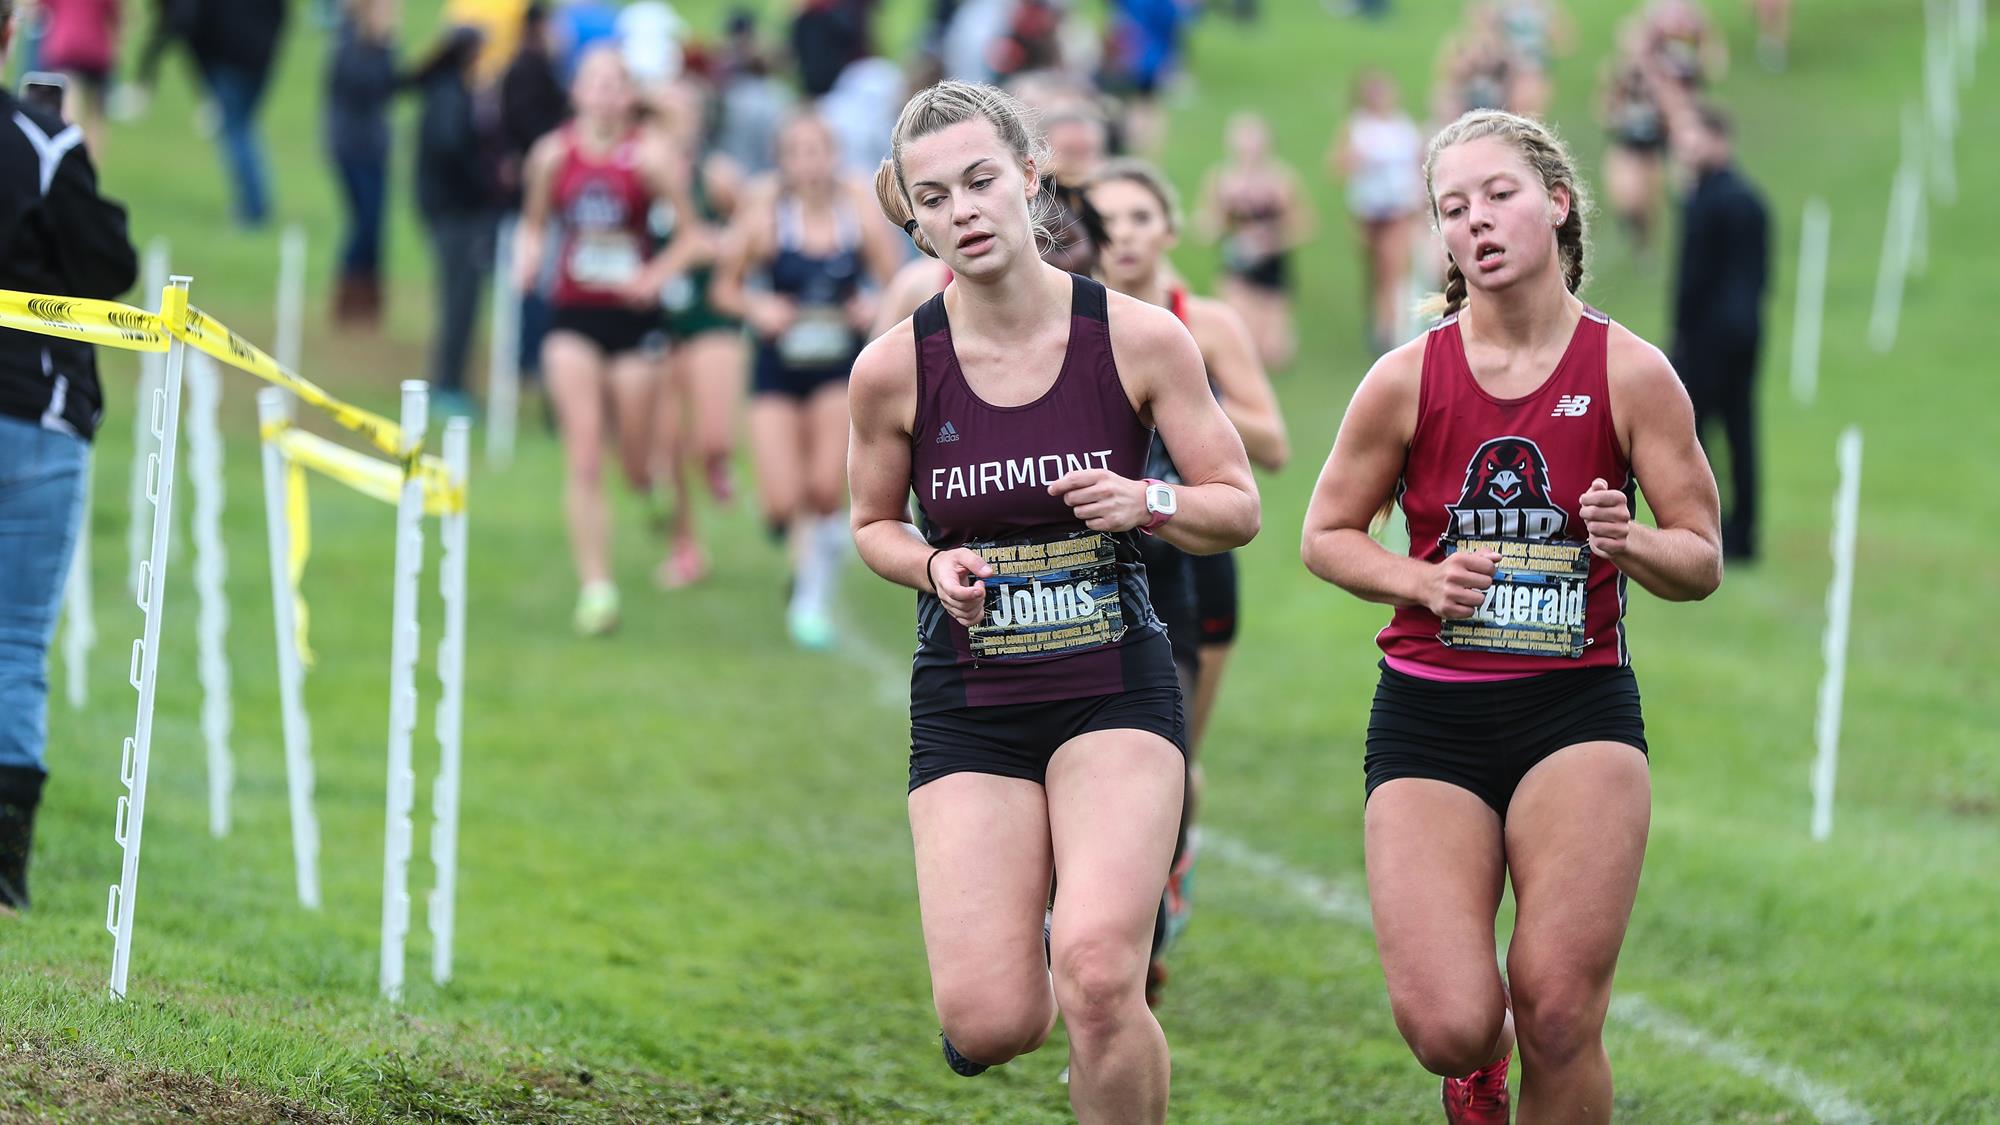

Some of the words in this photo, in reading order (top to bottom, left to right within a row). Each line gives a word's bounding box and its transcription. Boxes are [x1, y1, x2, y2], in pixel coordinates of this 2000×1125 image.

[1551, 395, 1591, 417] NB
[936, 431, 960, 444] adidas
[932, 450, 1113, 500] FAIRMONT
[972, 545, 1017, 563] IPPERY
[1018, 543, 1046, 561] ROCK
[1046, 534, 1101, 557] UNIVERSITY
[1501, 541, 1528, 558] ROCK
[1528, 543, 1581, 561] UNIVERSITY
[991, 580, 1095, 627] Johns
[1471, 581, 1584, 626] zgerald
